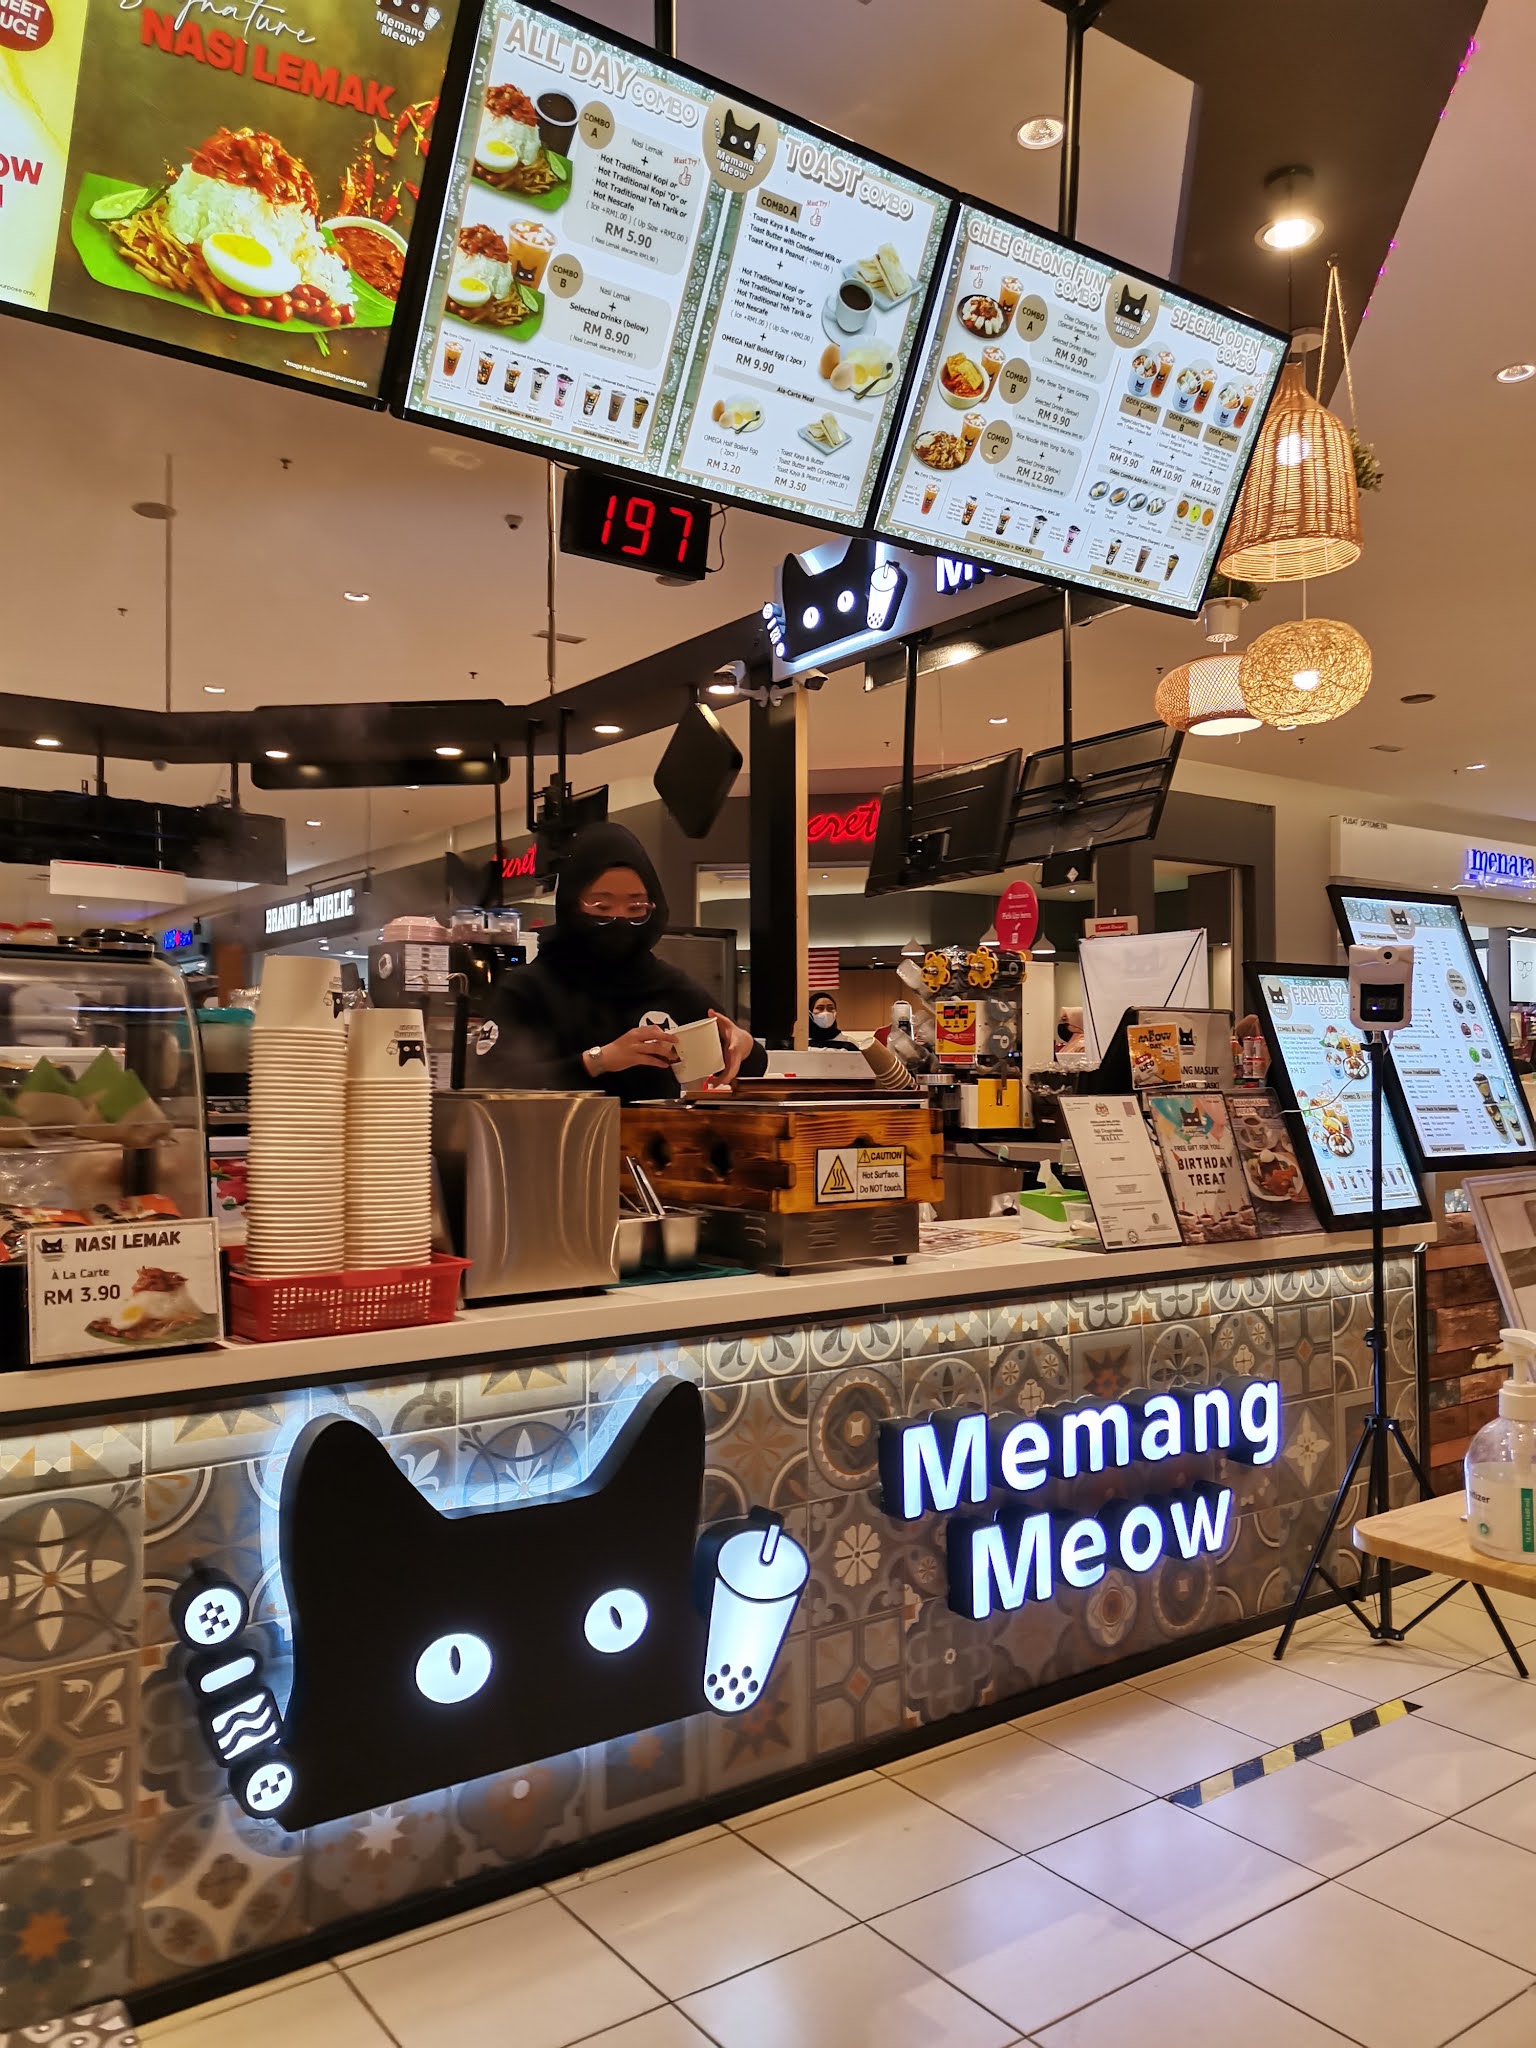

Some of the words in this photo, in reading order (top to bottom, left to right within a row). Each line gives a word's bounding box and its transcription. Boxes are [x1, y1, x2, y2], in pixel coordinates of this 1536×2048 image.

[375, 10, 426, 42] Memang
[381, 24, 417, 47] Meow
[140, 9, 248, 75] NASI
[253, 45, 396, 120] LEMAK
[503, 17, 564, 71] ALL
[569, 41, 636, 99] DAY
[630, 81, 698, 127] COMBO
[583, 111, 610, 130] COMBO
[590, 126, 598, 138] A
[631, 137, 644, 149] Nasi
[644, 142, 664, 157] Lemak
[600, 153, 613, 164] Hot
[614, 159, 652, 180] Traditional
[652, 174, 668, 187] Kopi
[715, 149, 754, 175] Memang
[719, 161, 747, 181] Meow
[597, 165, 611, 177] Hot
[611, 171, 649, 192] Traditional
[650, 186, 666, 199] Kopi
[679, 198, 687, 206] or
[786, 135, 862, 193] TOAST
[859, 183, 913, 219] COMBO
[592, 189, 606, 200] Hot
[607, 195, 635, 211] Nescafe
[595, 178, 608, 189] Hot
[609, 183, 647, 204] Traditional
[647, 197, 660, 208] Teh
[661, 203, 679, 215] Tarik
[760, 196, 789, 214] COMBO
[789, 205, 798, 218] A
[604, 221, 624, 239] RM
[626, 229, 652, 249] 5.90
[752, 212, 769, 224] Toast
[769, 219, 784, 231] Kaya
[783, 224, 789, 232] &
[790, 227, 808, 239] Butter
[747, 234, 763, 246] Toast
[763, 240, 778, 252] Kaya
[778, 246, 784, 254] &
[784, 248, 805, 261] Peanut
[749, 223, 765, 234] Toast
[765, 229, 783, 241] Butter
[783, 236, 795, 246] with
[795, 240, 824, 257] Condensed
[824, 252, 835, 262] Milk
[968, 219, 1009, 254] CHEE
[1010, 239, 1075, 278] CHEONG
[1076, 267, 1108, 294] FUN
[552, 264, 579, 279] COMBO
[741, 266, 753, 276] Hot
[753, 270, 784, 288] Traditional
[783, 282, 797, 294] Kopi
[559, 277, 567, 288] B
[738, 277, 750, 287] Hot
[750, 281, 781, 298] Traditional
[781, 292, 795, 304] Kopi
[598, 285, 611, 296] Nasi
[611, 290, 631, 303] Lemak
[736, 287, 748, 297] Hot
[748, 291, 779, 308] Traditional
[779, 302, 790, 312] Teh
[790, 307, 805, 317] Tarik
[1055, 279, 1101, 311] COMBO
[734, 298, 745, 308] Hot
[745, 302, 769, 316] Nescafe
[1021, 306, 1045, 321] COMBO
[569, 301, 599, 318] Selected
[600, 311, 622, 325] Drinks
[622, 319, 649, 335] (below)
[1026, 320, 1034, 331] A
[1113, 315, 1141, 335] Memang
[582, 320, 602, 336] RM
[604, 327, 630, 345] 8.90
[1115, 325, 1135, 340] Meow
[1170, 308, 1223, 340] SPECIAL
[1224, 331, 1261, 358] ODEN
[721, 333, 743, 346] OMEGA
[743, 340, 756, 350] Half
[756, 344, 774, 356] Boiled
[773, 351, 785, 361] Egg
[789, 356, 802, 366] 2pcs
[1054, 347, 1069, 360] RM
[1068, 352, 1088, 368] 9.90
[735, 353, 751, 366] RM
[753, 358, 774, 374] 9.90
[1217, 347, 1257, 374] COMBO
[1004, 369, 1028, 384] COMBO
[1009, 383, 1017, 394] B
[1124, 397, 1139, 407] ODEN
[1139, 402, 1157, 413] COMBO
[1037, 408, 1051, 421] RM
[1051, 412, 1071, 427] 9.90
[1168, 412, 1182, 422] ODEN
[1182, 417, 1199, 428] COMBO
[986, 431, 1010, 445] COMBO
[1208, 426, 1222, 436] ODEN
[1221, 431, 1237, 442] COMBO
[990, 444, 998, 455] C
[706, 458, 720, 469] RM
[721, 462, 741, 474] 3.20
[1109, 452, 1121, 462] RM
[1122, 456, 1139, 468] 9.90
[1015, 465, 1030, 478] RM
[1030, 470, 1055, 485] 12.90
[1149, 465, 1162, 476] RM
[1162, 469, 1183, 482] 10.90
[773, 476, 787, 486] RM
[788, 480, 806, 492] 3.50
[1189, 479, 1202, 489] RM
[1201, 483, 1221, 495] 12.90
[601, 494, 693, 563] 197
[1471, 848, 1535, 878] menara
[265, 903, 298, 934] BRAND
[300, 888, 355, 927] REPUBLIC
[1290, 986, 1344, 1005] FAMILY
[1319, 1006, 1350, 1019] COMBO
[1194, 1065, 1219, 1076] MASUK
[870, 1151, 902, 1161] CAUTION
[1177, 1156, 1233, 1171] BIRTHDAY
[862, 1171, 874, 1179] Hot
[874, 1170, 900, 1179] Surface.
[1188, 1172, 1226, 1186] TREAT
[860, 1185, 869, 1193] Do
[869, 1184, 883, 1193] NOT
[884, 1183, 903, 1192] touch.
[75, 1234, 116, 1253] NASI
[122, 1230, 181, 1249] LEMAK
[63, 1270, 76, 1280] La
[80, 1268, 110, 1279] Carte
[44, 1288, 73, 1306] RM
[80, 1284, 120, 1303] 3.90
[899, 1379, 1281, 1520] Memang
[972, 1487, 1233, 1621] Meow
